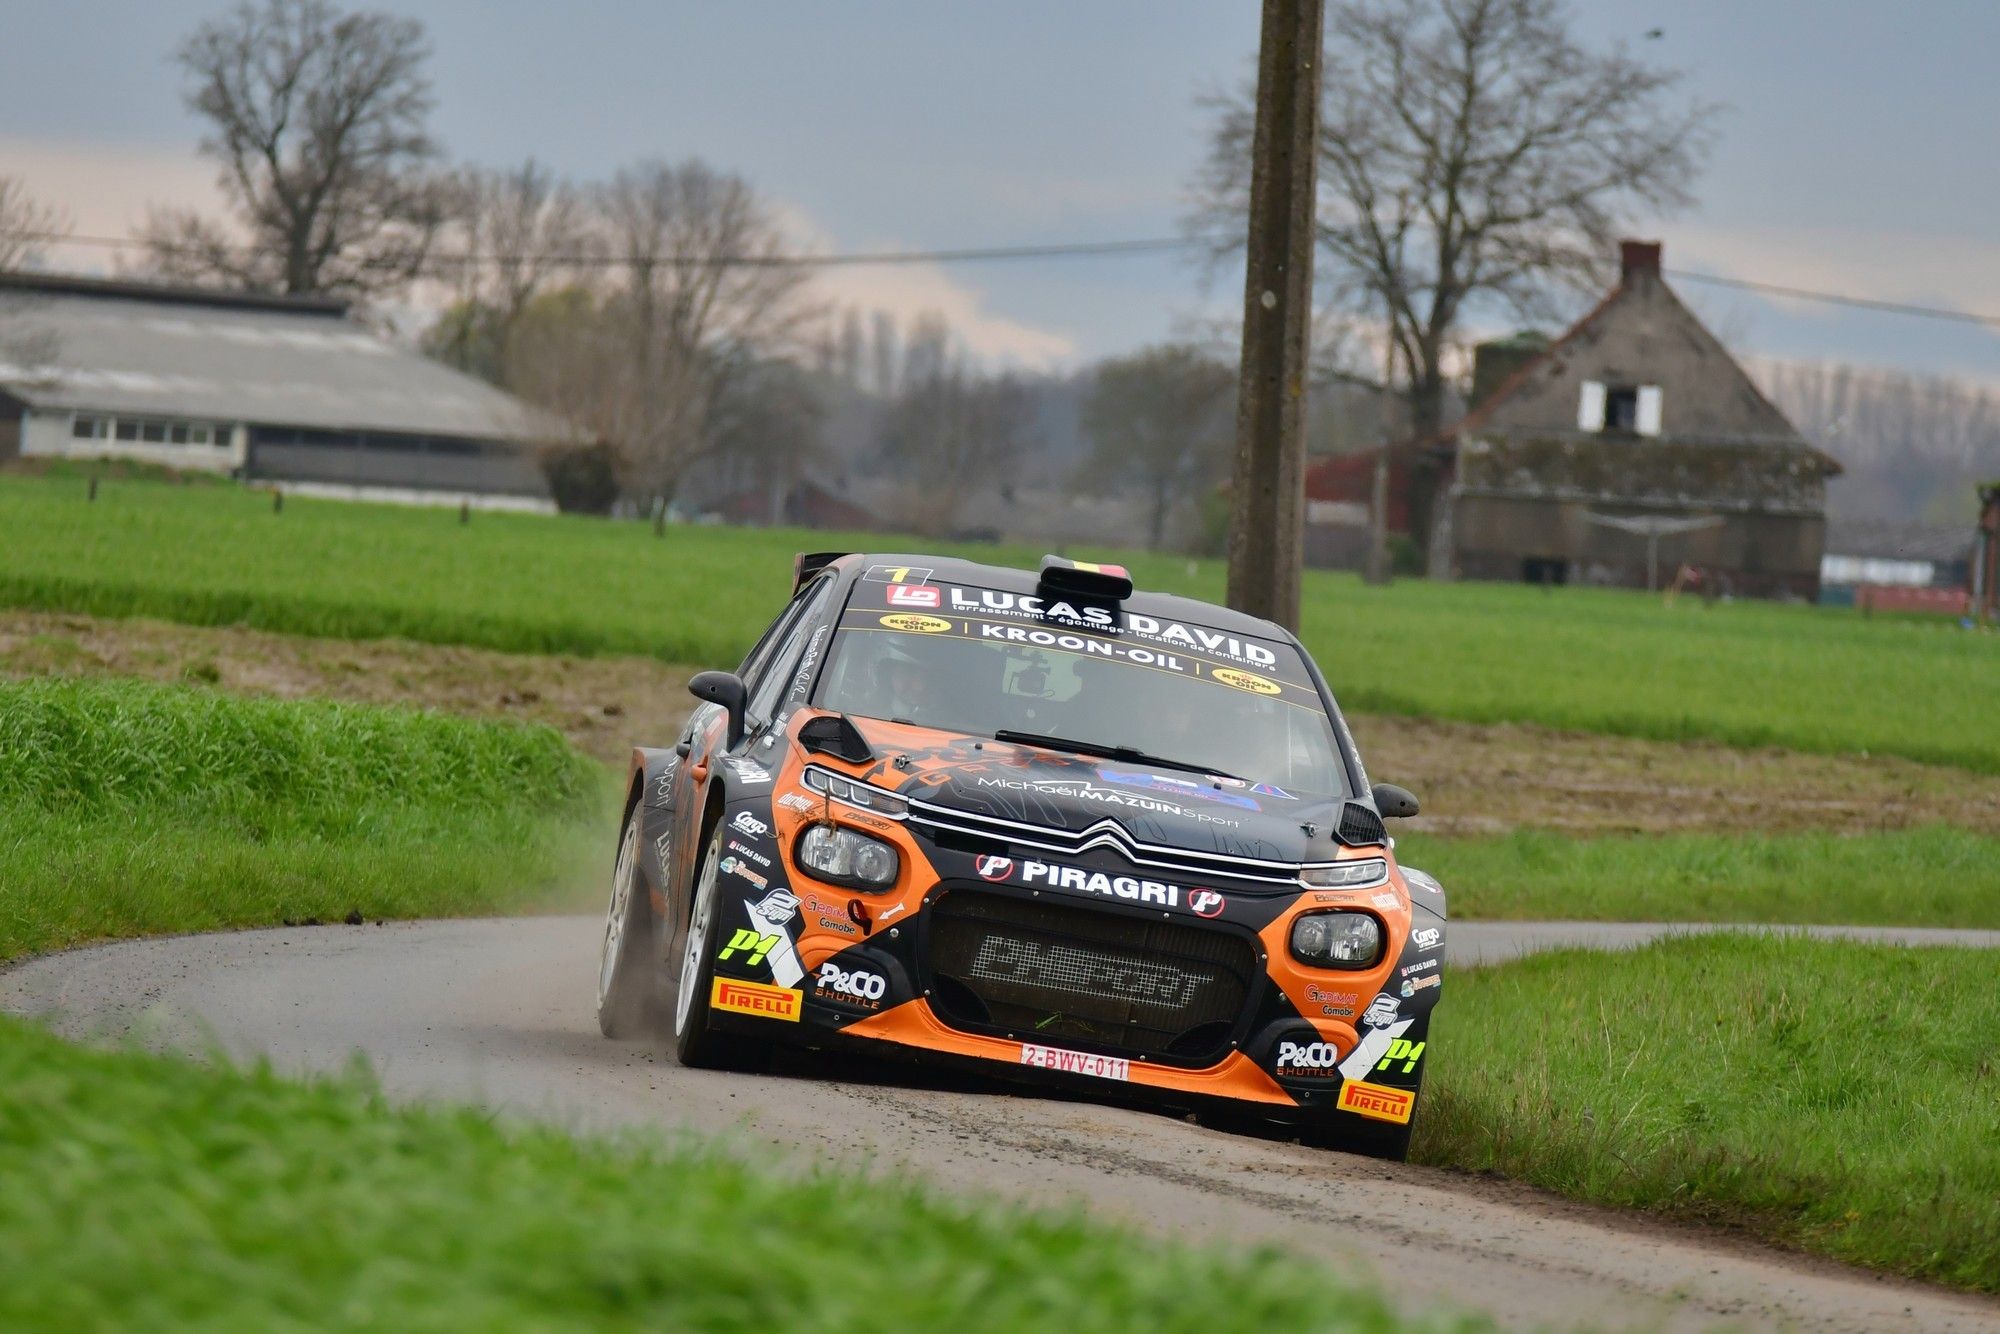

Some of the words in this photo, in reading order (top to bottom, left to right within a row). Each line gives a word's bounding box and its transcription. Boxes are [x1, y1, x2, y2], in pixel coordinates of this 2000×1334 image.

[885, 567, 911, 582] 1
[889, 618, 941, 628] KROON
[951, 588, 1113, 624] LUCAS
[1129, 613, 1276, 665] DAVID
[952, 603, 1044, 620] terrassement
[1057, 615, 1125, 634] égouttage
[1136, 630, 1187, 648] location
[1190, 642, 1205, 652] de
[1207, 648, 1276, 671] containers
[982, 624, 1183, 671] KROON-OIL
[1222, 672, 1272, 690] KROON
[1235, 681, 1257, 691] OIL
[735, 811, 768, 834] Cargo
[735, 843, 755, 858] LUCAS
[752, 853, 771, 867] DAVID
[1023, 860, 1178, 907] PIRAGRI
[819, 917, 856, 934] Comobe
[1412, 928, 1439, 945] Cargo
[718, 928, 782, 966] P1
[1407, 963, 1423, 974] LUCAS
[1423, 959, 1437, 969] DAVID
[816, 962, 886, 999] P&CO
[719, 983, 794, 1015] PIRELLI
[815, 987, 880, 1010] SHUTTLE
[1322, 1004, 1354, 1017] Comobe
[1026, 1046, 1127, 1081] 2-BWV-011
[1277, 1041, 1338, 1067] P&CO
[1377, 1038, 1426, 1074] P1
[1276, 1066, 1334, 1078] SHUTTLE
[1345, 1084, 1408, 1117] PIRELLI
